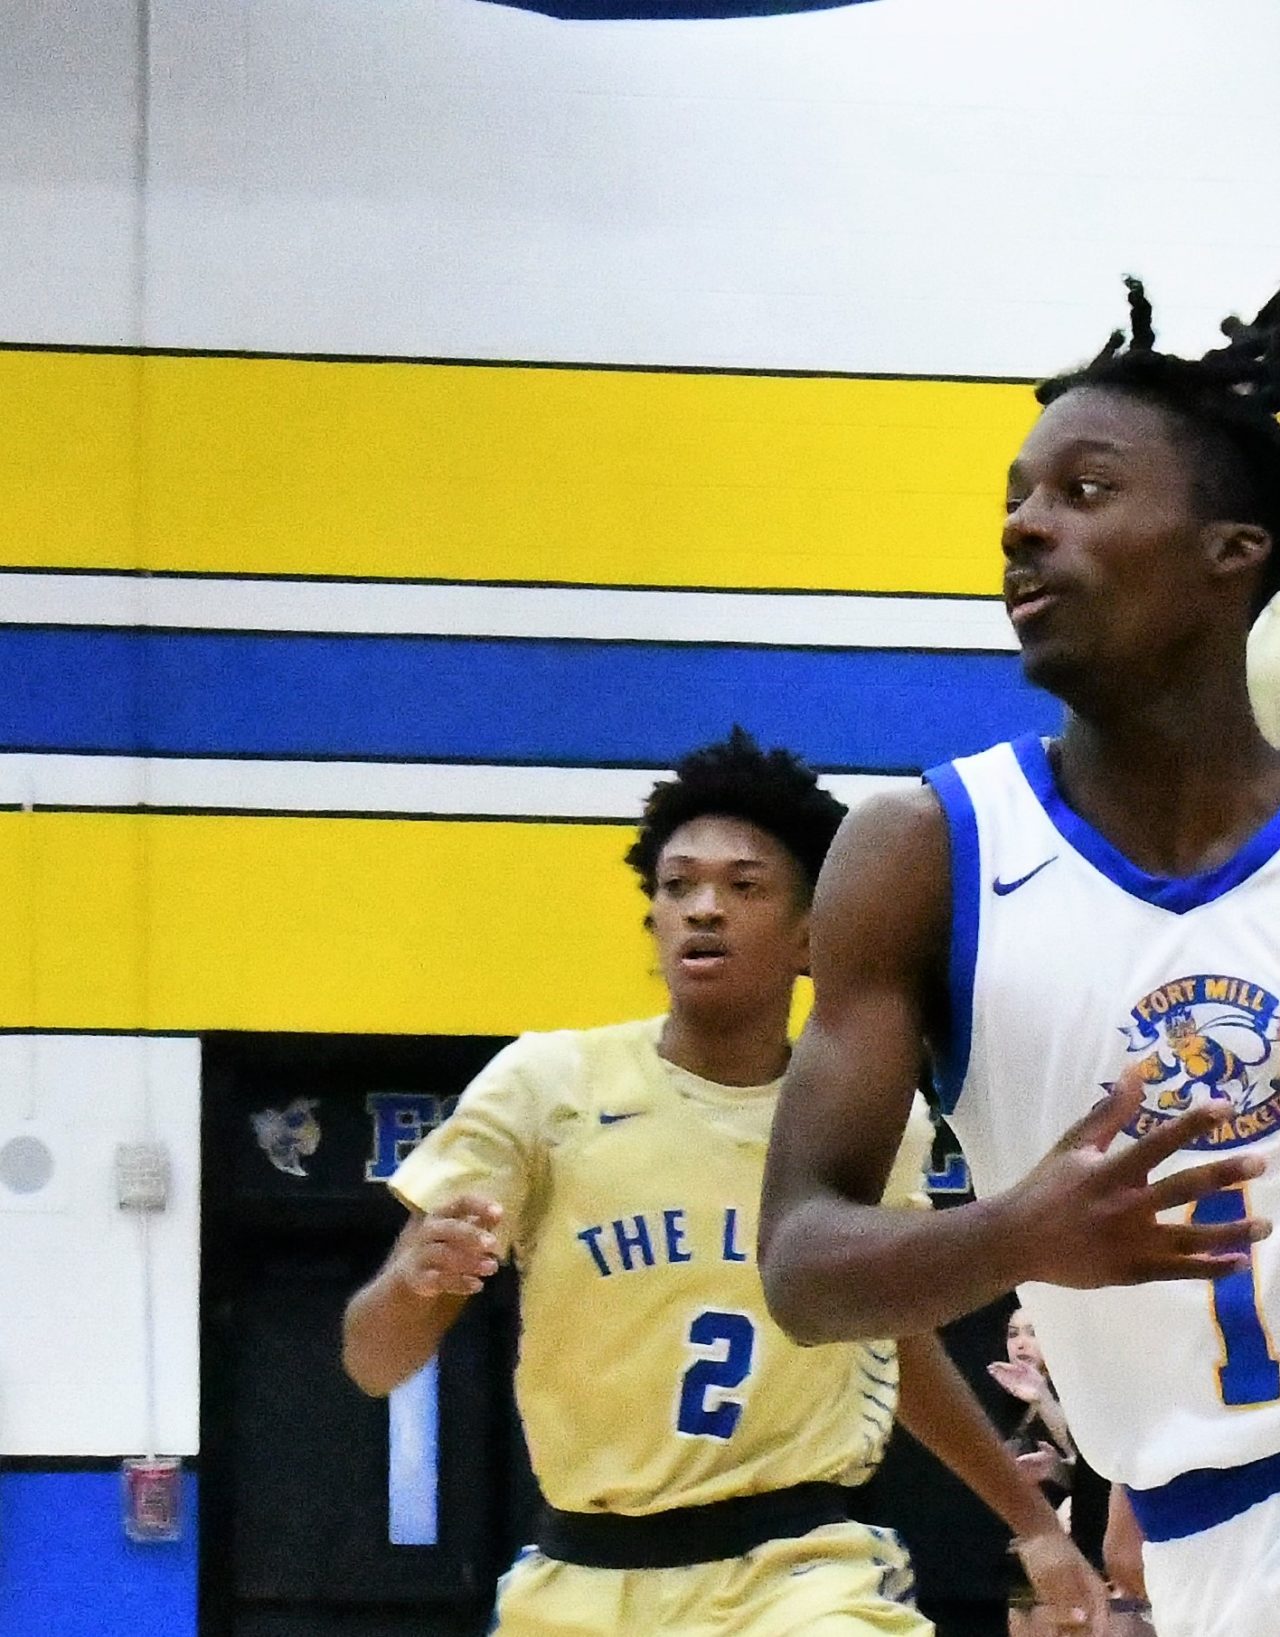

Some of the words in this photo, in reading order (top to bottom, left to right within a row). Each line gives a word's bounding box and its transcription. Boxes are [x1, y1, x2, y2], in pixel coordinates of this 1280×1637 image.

[1136, 980, 1196, 1019] FORT
[1204, 978, 1265, 1011] MILL
[577, 1208, 692, 1276] THE
[676, 1308, 756, 1441] 2
